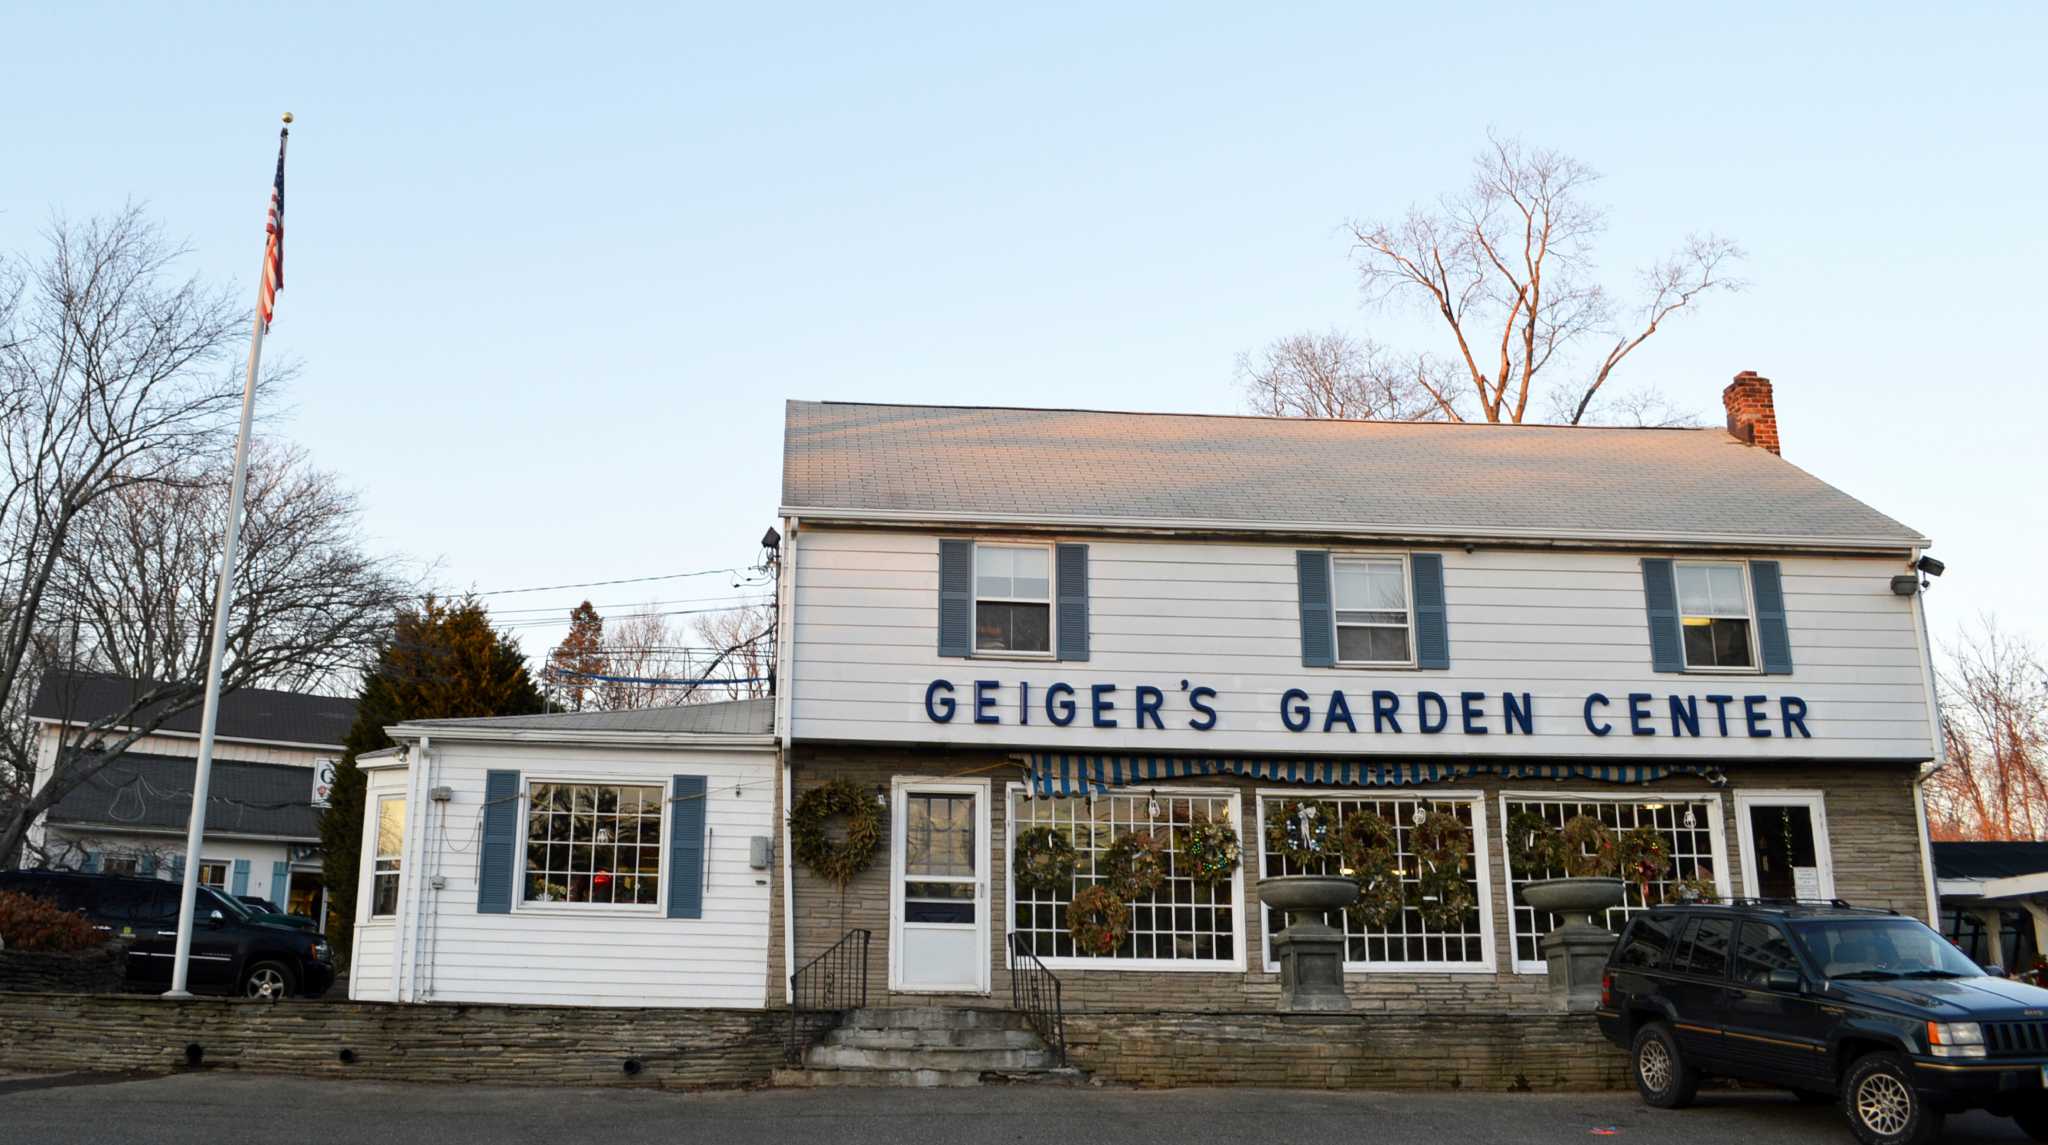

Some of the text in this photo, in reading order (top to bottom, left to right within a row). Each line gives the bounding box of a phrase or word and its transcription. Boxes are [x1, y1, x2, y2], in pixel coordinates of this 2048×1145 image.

[925, 678, 1811, 738] GEIGER'S GARDEN CENTER
